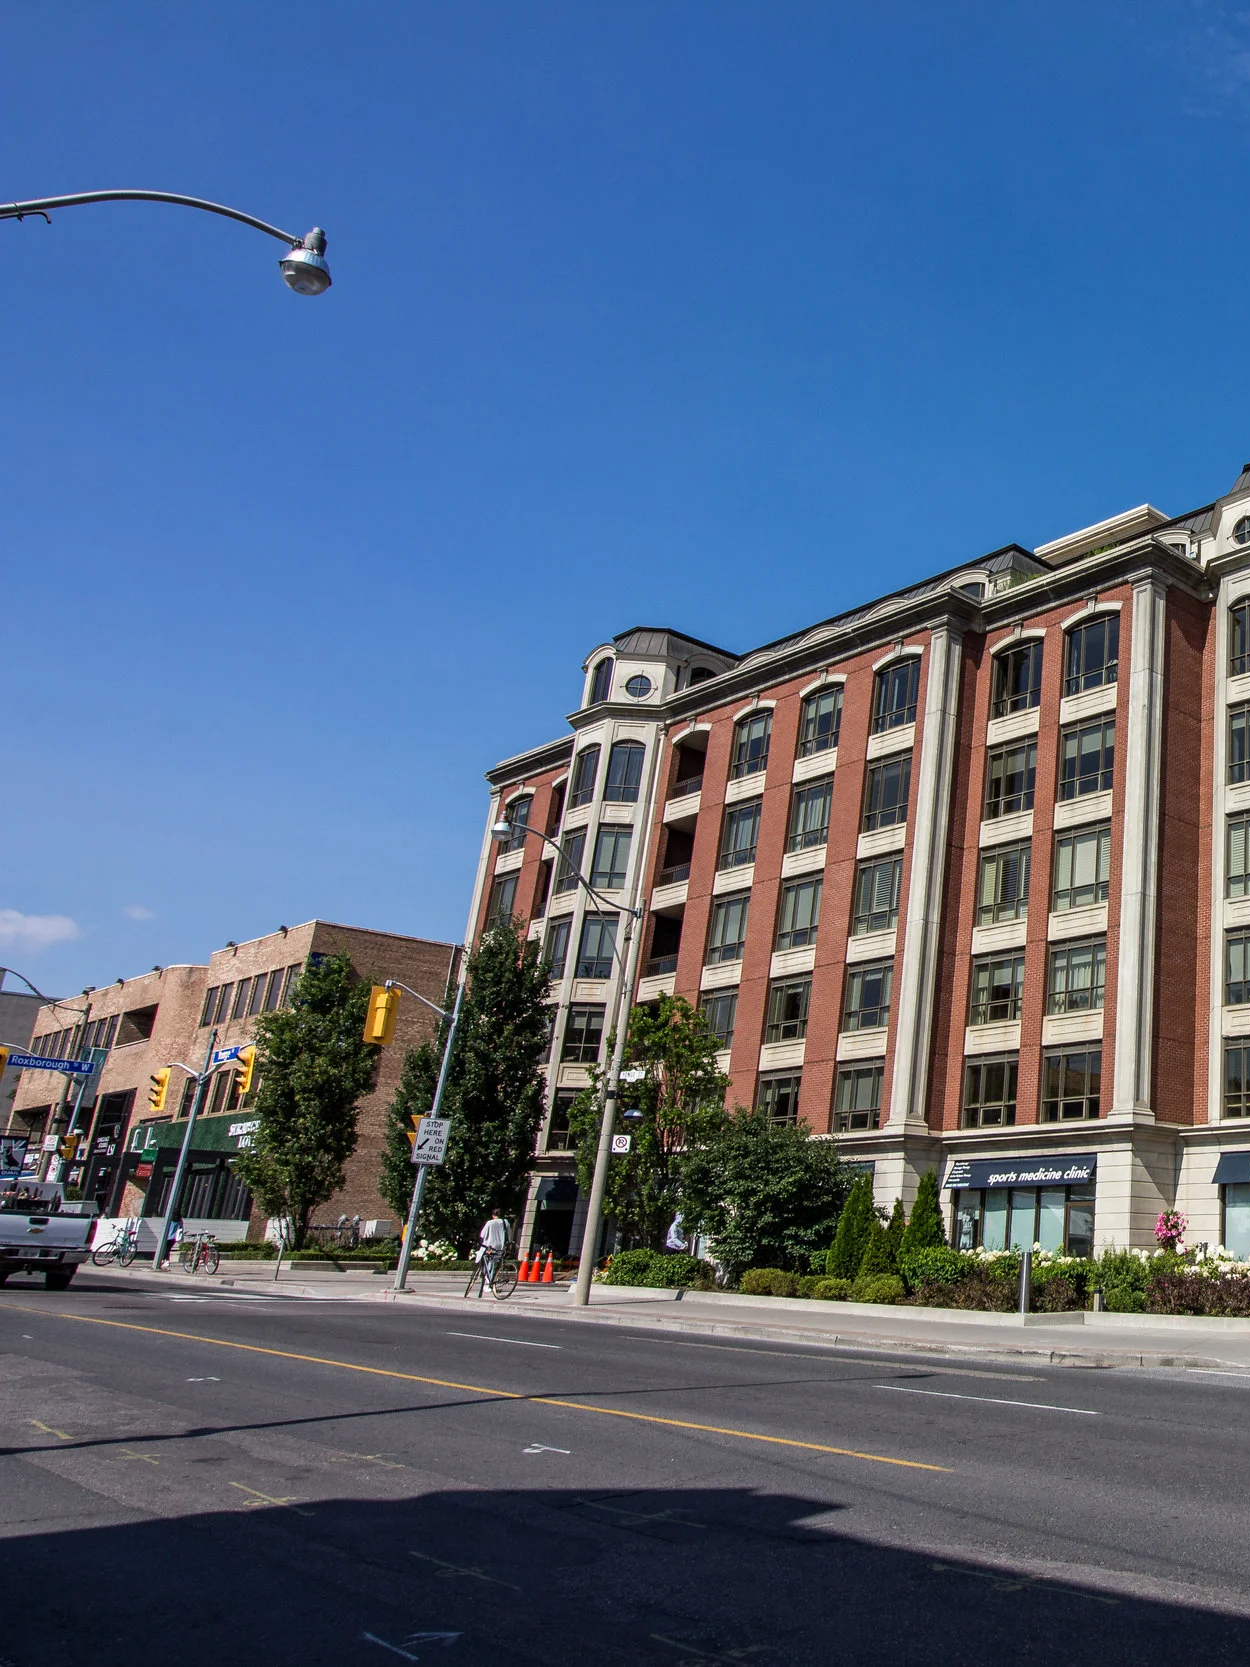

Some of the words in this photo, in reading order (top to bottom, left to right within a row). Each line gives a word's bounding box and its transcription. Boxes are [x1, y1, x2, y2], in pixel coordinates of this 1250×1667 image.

[11, 1055, 70, 1071] Roxborough
[81, 1063, 90, 1071] W
[988, 1172, 1017, 1186] sports
[1018, 1167, 1062, 1182] medicine
[1063, 1166, 1091, 1179] clinic
